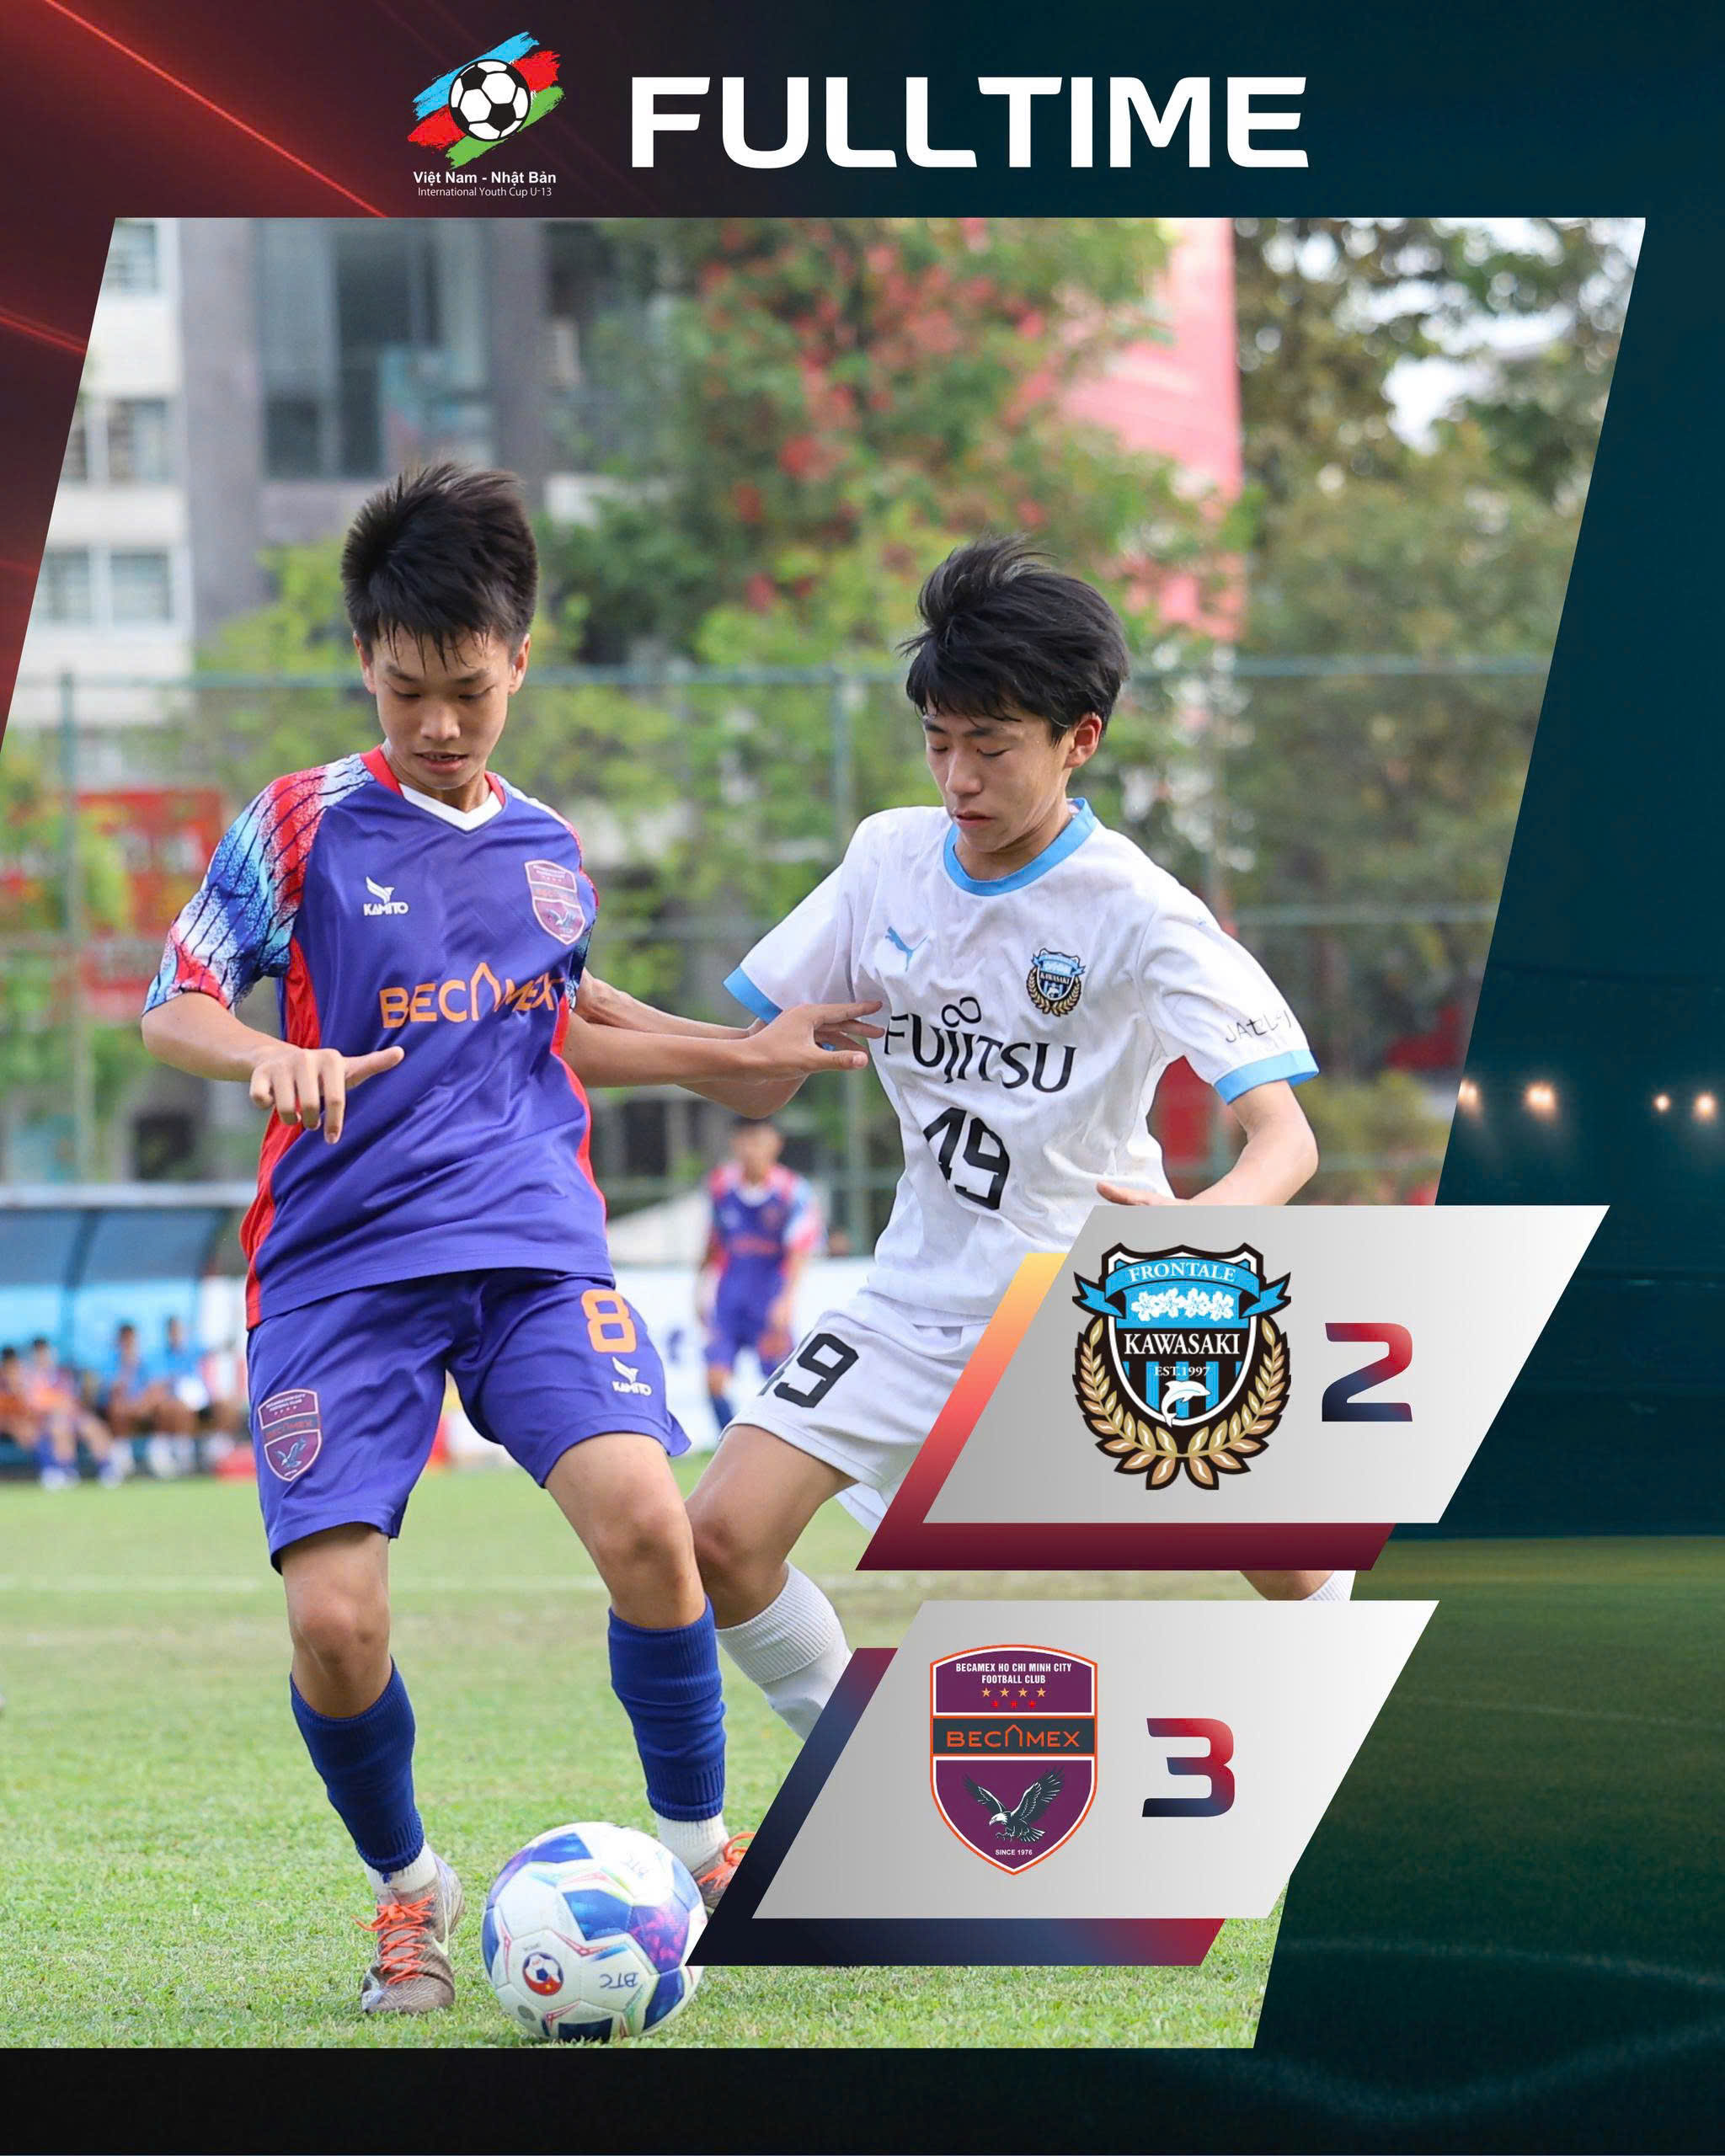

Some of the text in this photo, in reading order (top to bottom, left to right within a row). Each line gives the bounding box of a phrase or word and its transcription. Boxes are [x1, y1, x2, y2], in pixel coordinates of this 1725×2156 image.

[363, 901, 409, 916] KAMITO
[884, 1013, 1077, 1093] FUJITSU
[923, 1107, 1011, 1211] 19
[580, 1289, 638, 1355] 8
[600, 1972, 639, 1990] BTC
